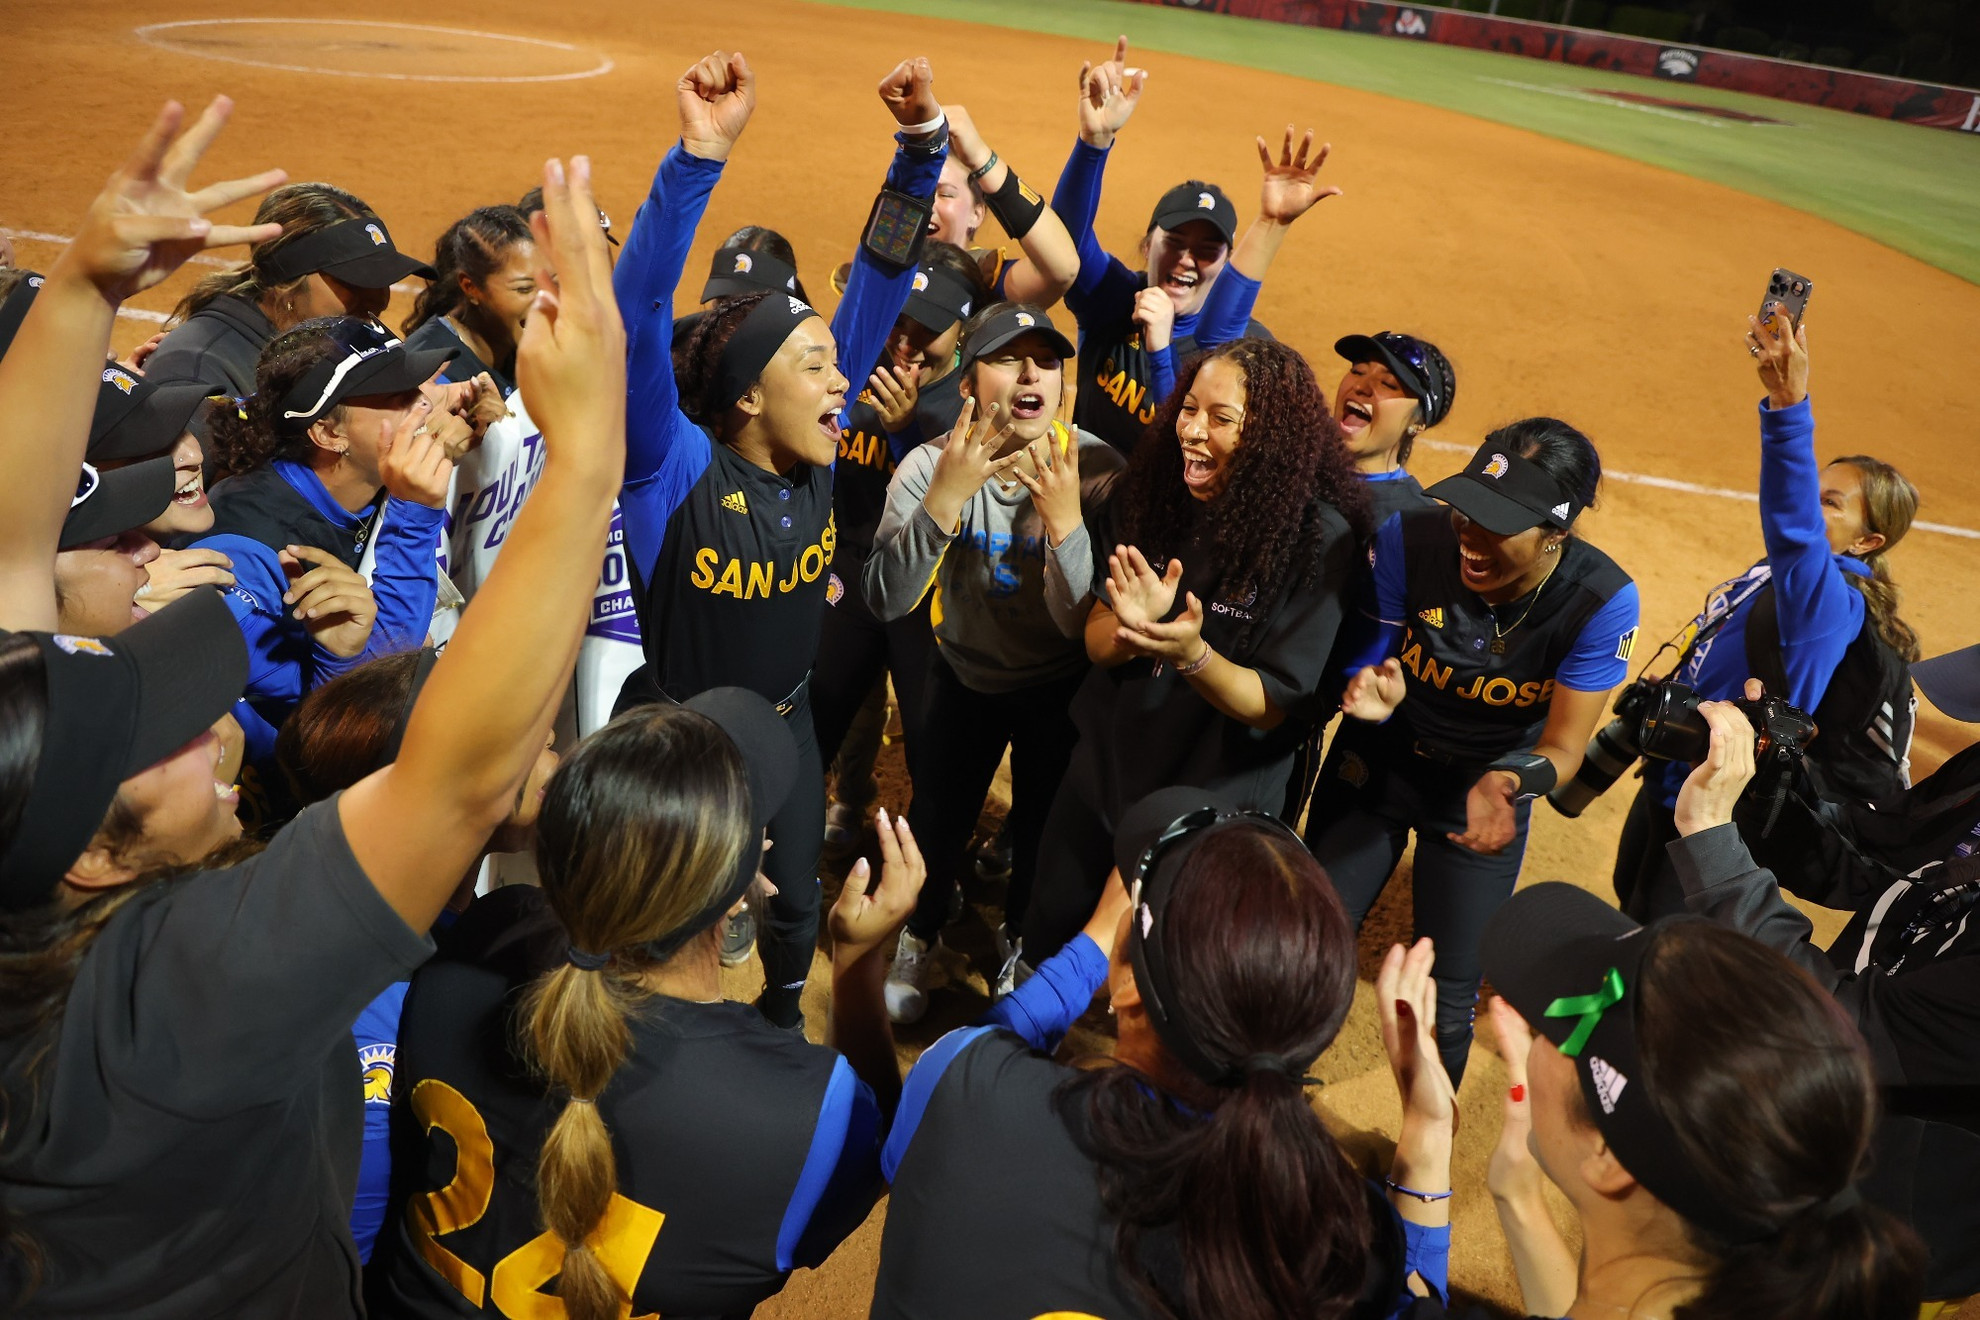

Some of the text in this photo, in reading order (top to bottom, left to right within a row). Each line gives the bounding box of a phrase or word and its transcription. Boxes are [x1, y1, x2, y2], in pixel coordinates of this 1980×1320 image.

[1097, 358, 1146, 414] SAN
[838, 428, 887, 471] SAN
[720, 498, 749, 515] adidas
[690, 547, 774, 600] SAN
[1418, 611, 1445, 629] adidas
[1456, 676, 1555, 708] JOSE
[1589, 1056, 1615, 1115] adidas
